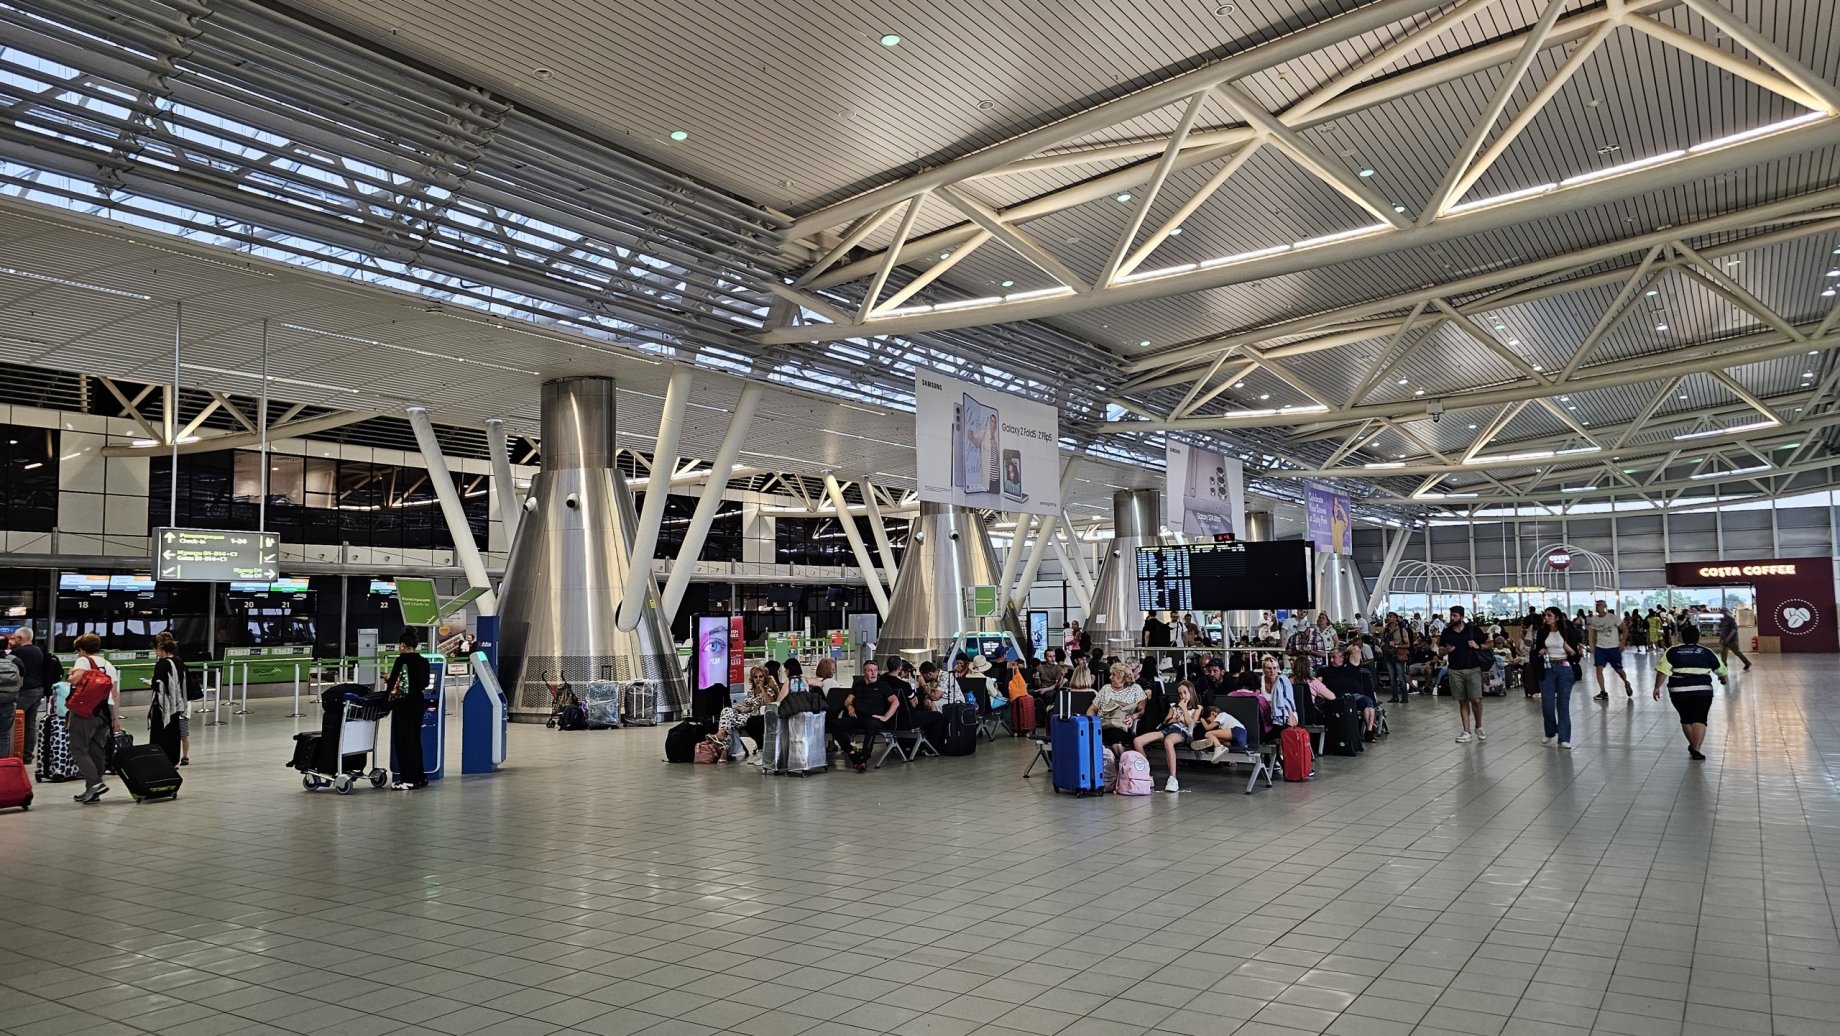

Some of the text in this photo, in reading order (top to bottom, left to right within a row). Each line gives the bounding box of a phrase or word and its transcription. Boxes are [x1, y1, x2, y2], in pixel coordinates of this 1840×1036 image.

[921, 379, 943, 391] SAMSUNG
[1001, 422, 1020, 437] Galaxy
[1024, 427, 1037, 438] Fold5
[1042, 431, 1053, 444] Flip5
[1699, 564, 1796, 578] COSTA COFFEE
[78, 601, 89, 609] 18
[124, 601, 135, 609] 19
